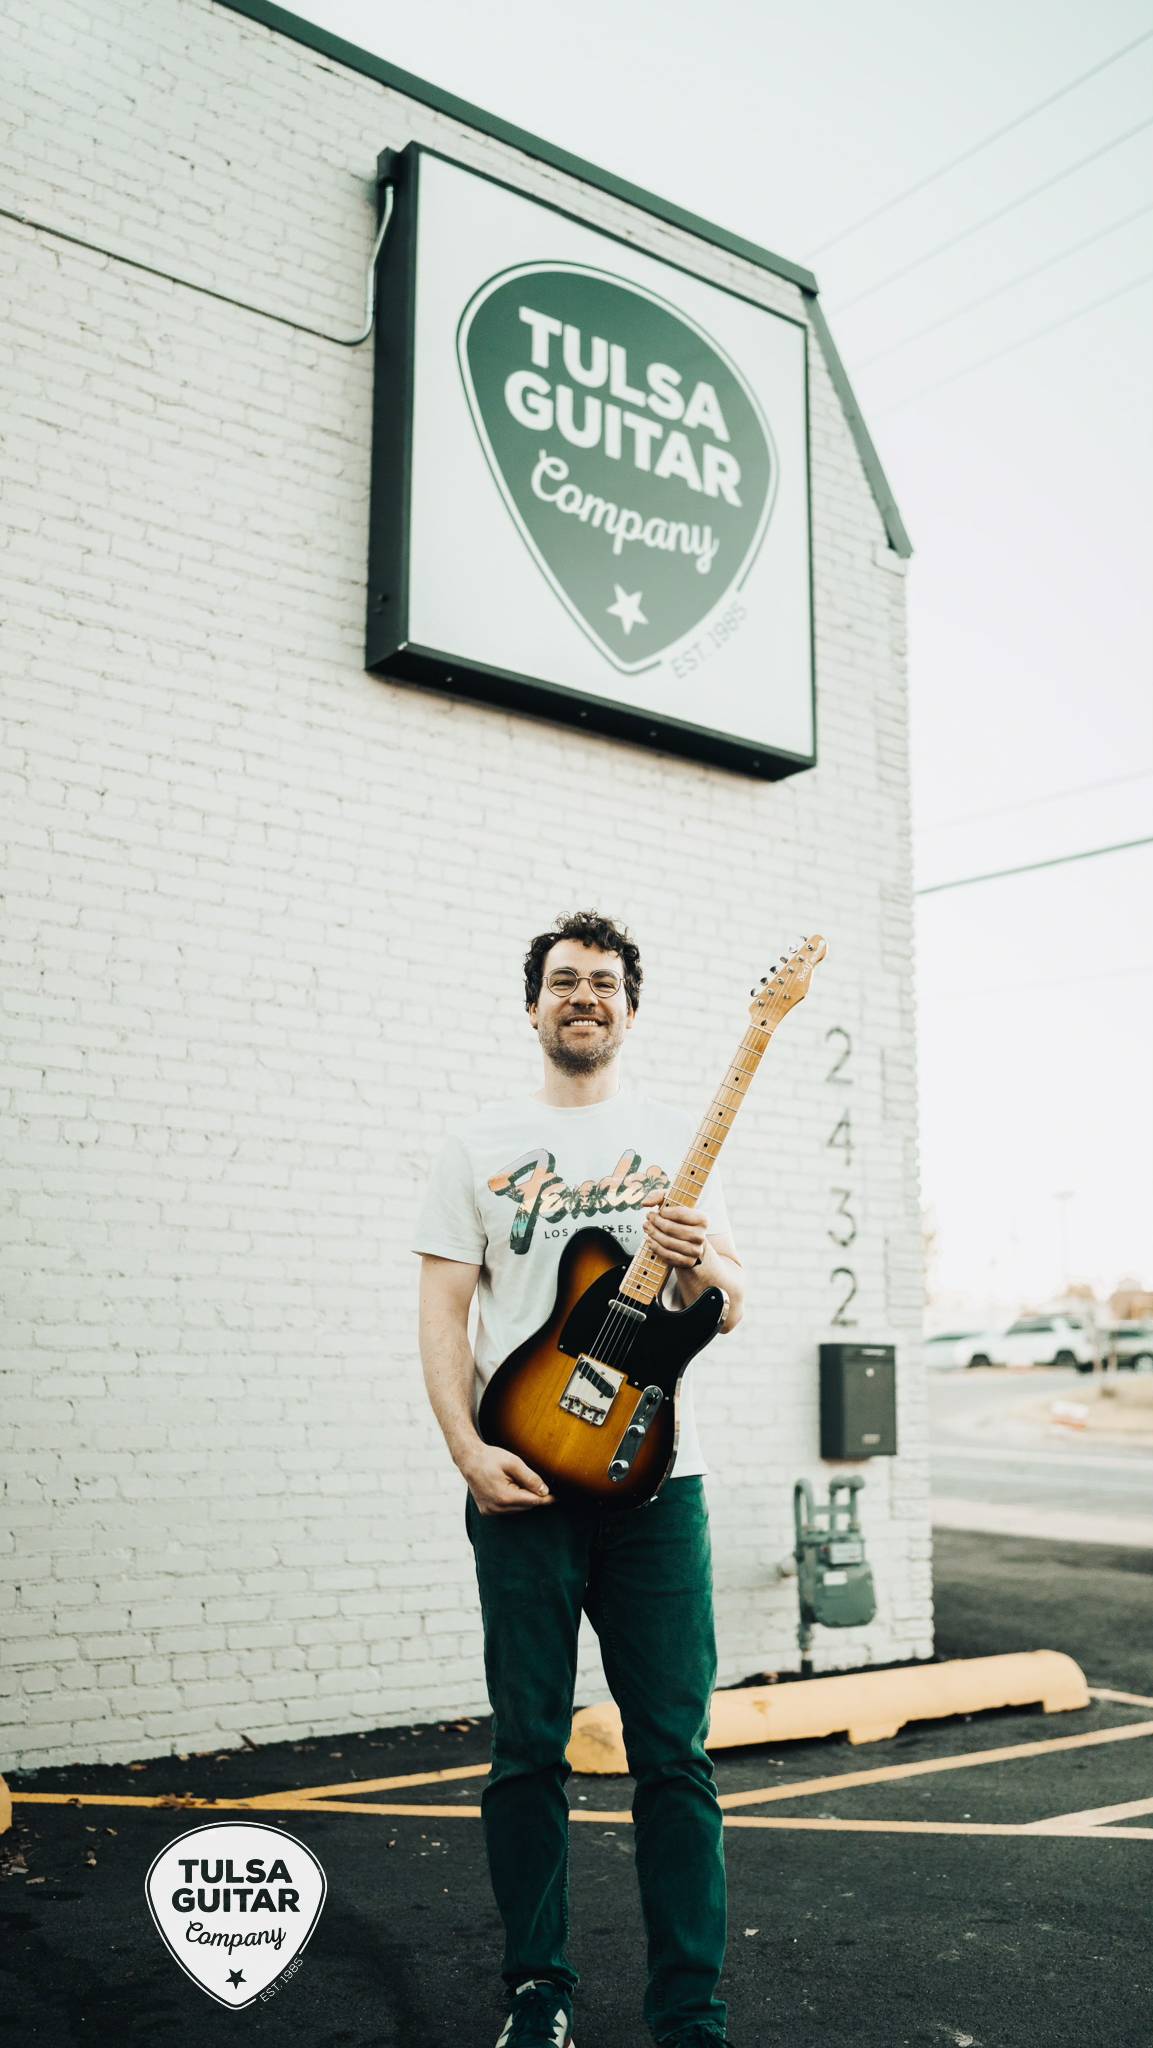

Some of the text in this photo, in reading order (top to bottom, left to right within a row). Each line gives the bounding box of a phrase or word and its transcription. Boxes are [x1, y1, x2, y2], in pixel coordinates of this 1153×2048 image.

[504, 370, 743, 508] GUITAR
[519, 305, 731, 443] TULSA
[530, 449, 719, 575] Company
[707, 600, 747, 649] 1985
[544, 1228, 569, 1239] LOS
[826, 1026, 857, 1327] 2432
